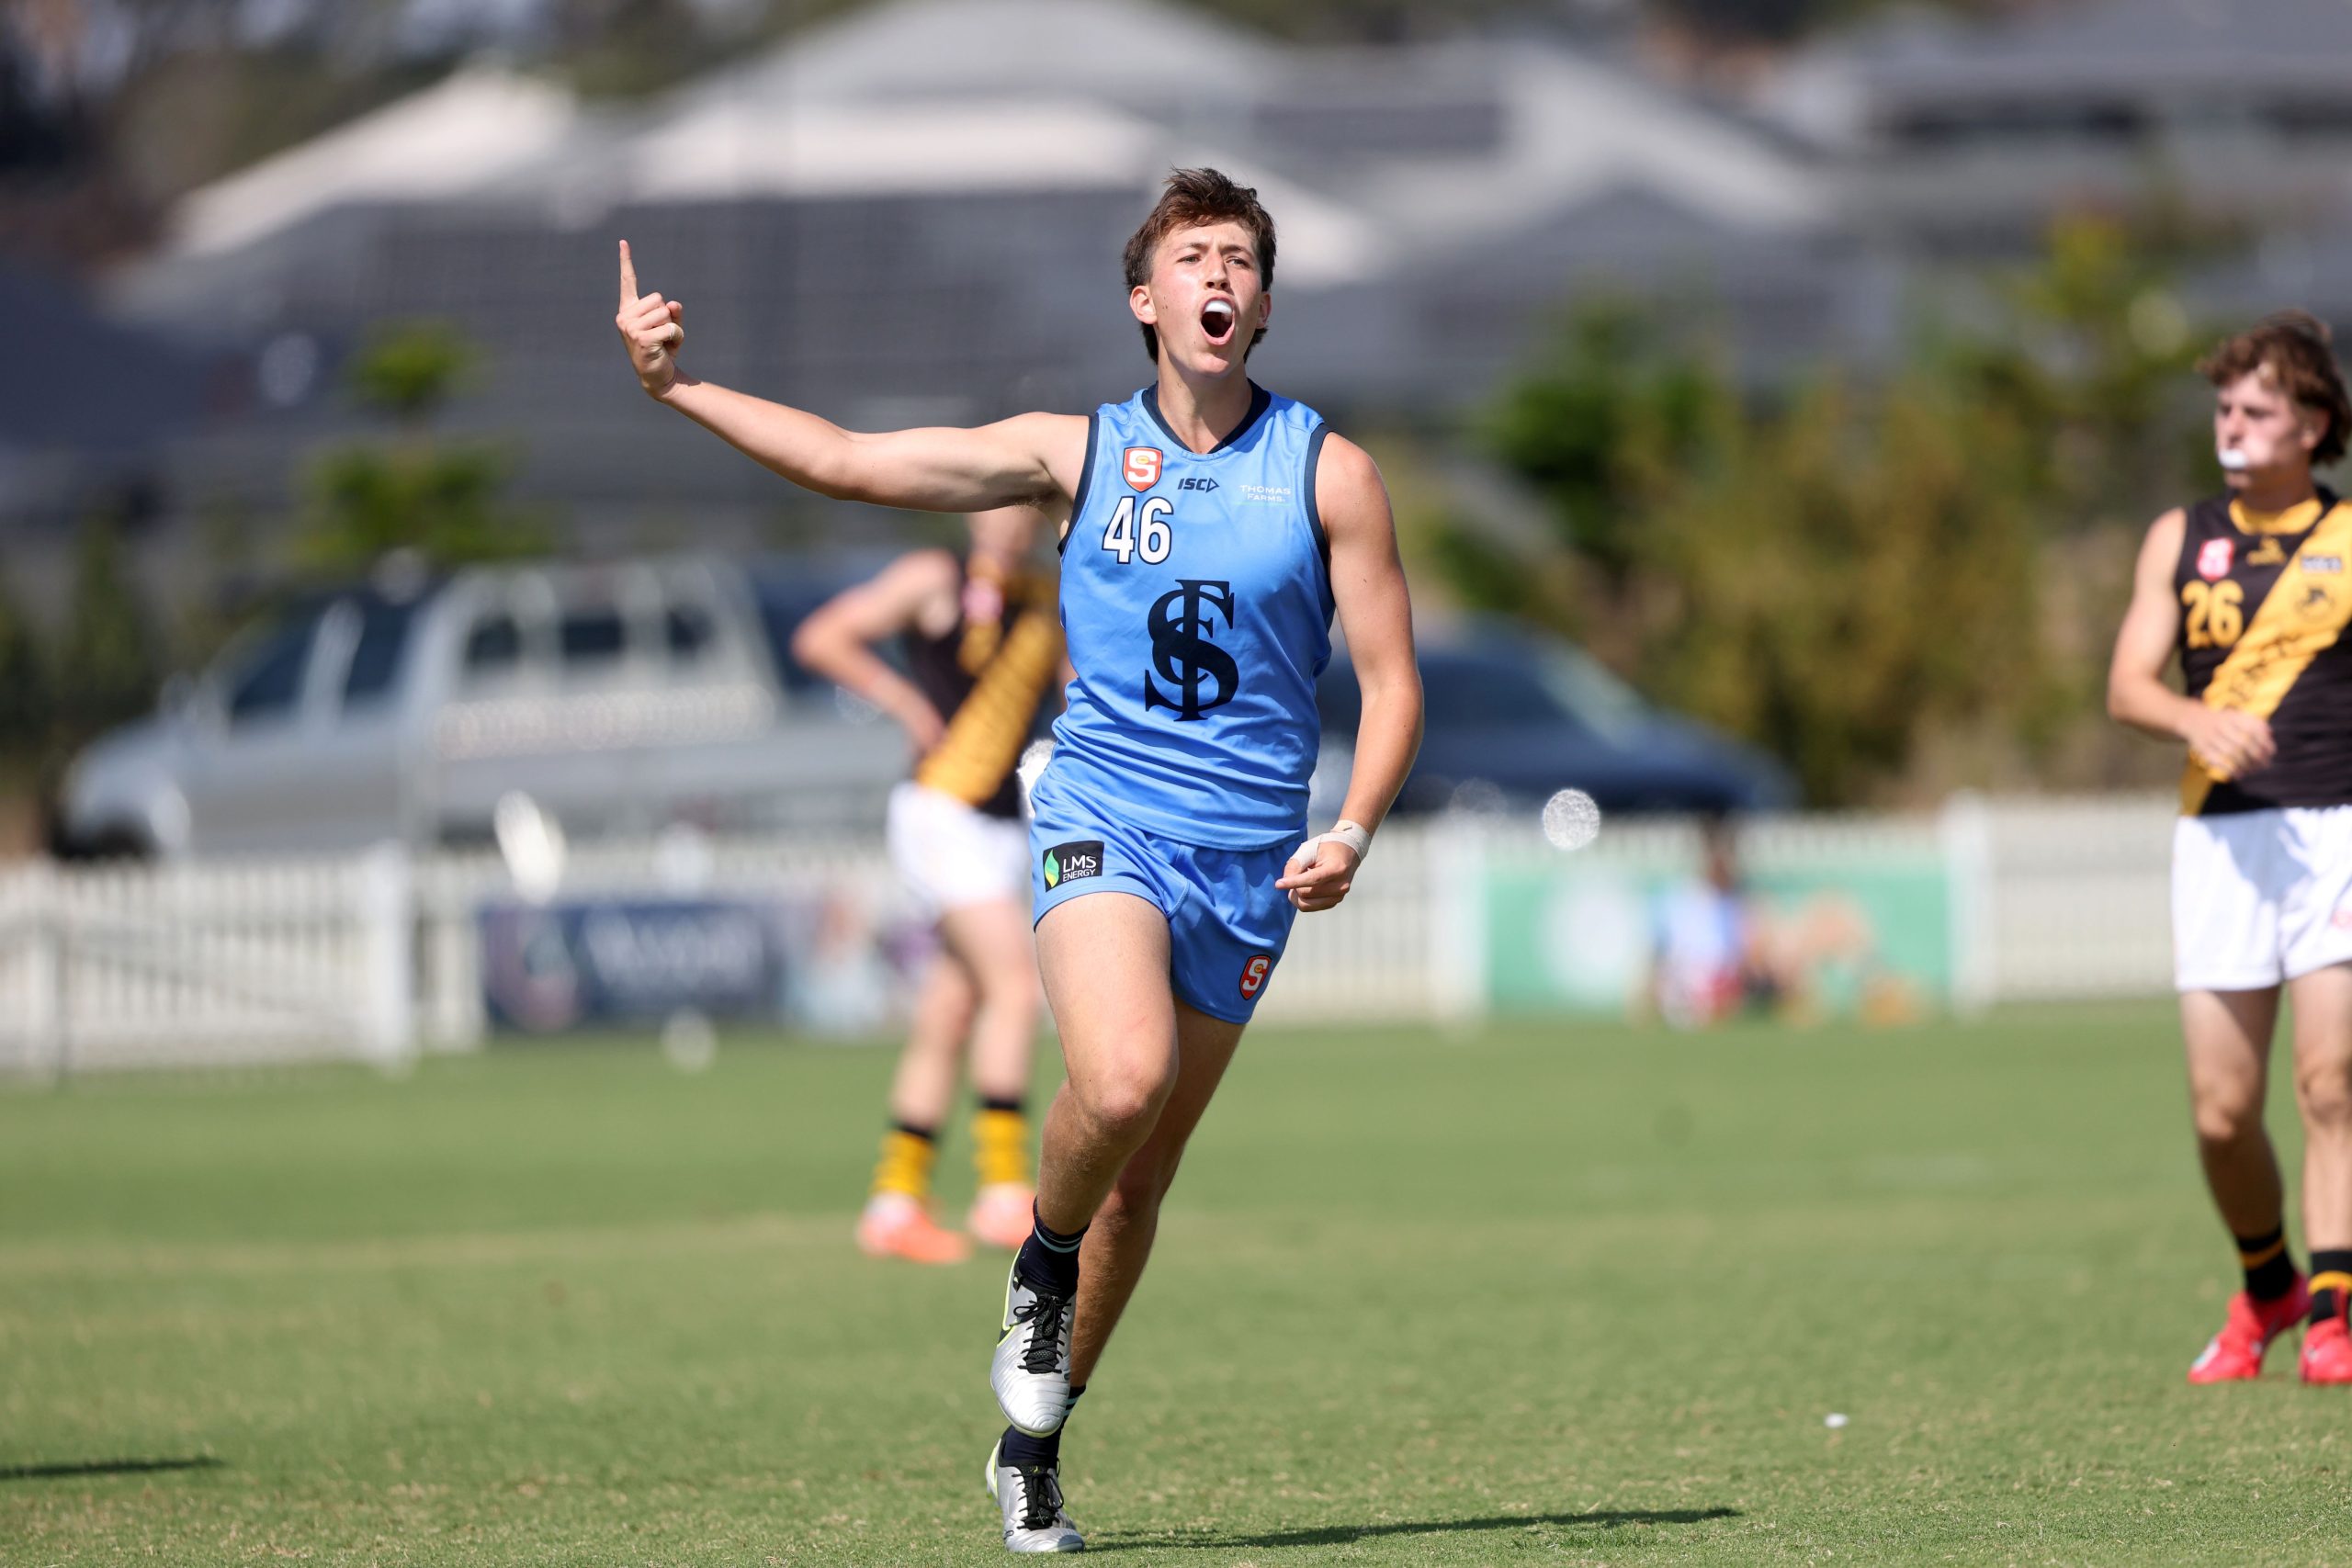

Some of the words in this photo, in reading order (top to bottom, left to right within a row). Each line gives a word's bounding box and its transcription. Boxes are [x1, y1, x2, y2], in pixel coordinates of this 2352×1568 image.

[1126, 449, 1158, 483] S
[1177, 478, 1208, 491] ISC
[1240, 484, 1292, 496] THOMAS
[1102, 496, 1174, 565] 46
[2181, 580, 2244, 649] 26
[1062, 868, 1096, 883] ENERGY
[1063, 855, 1096, 873] LMS
[1242, 958, 1268, 990] S
